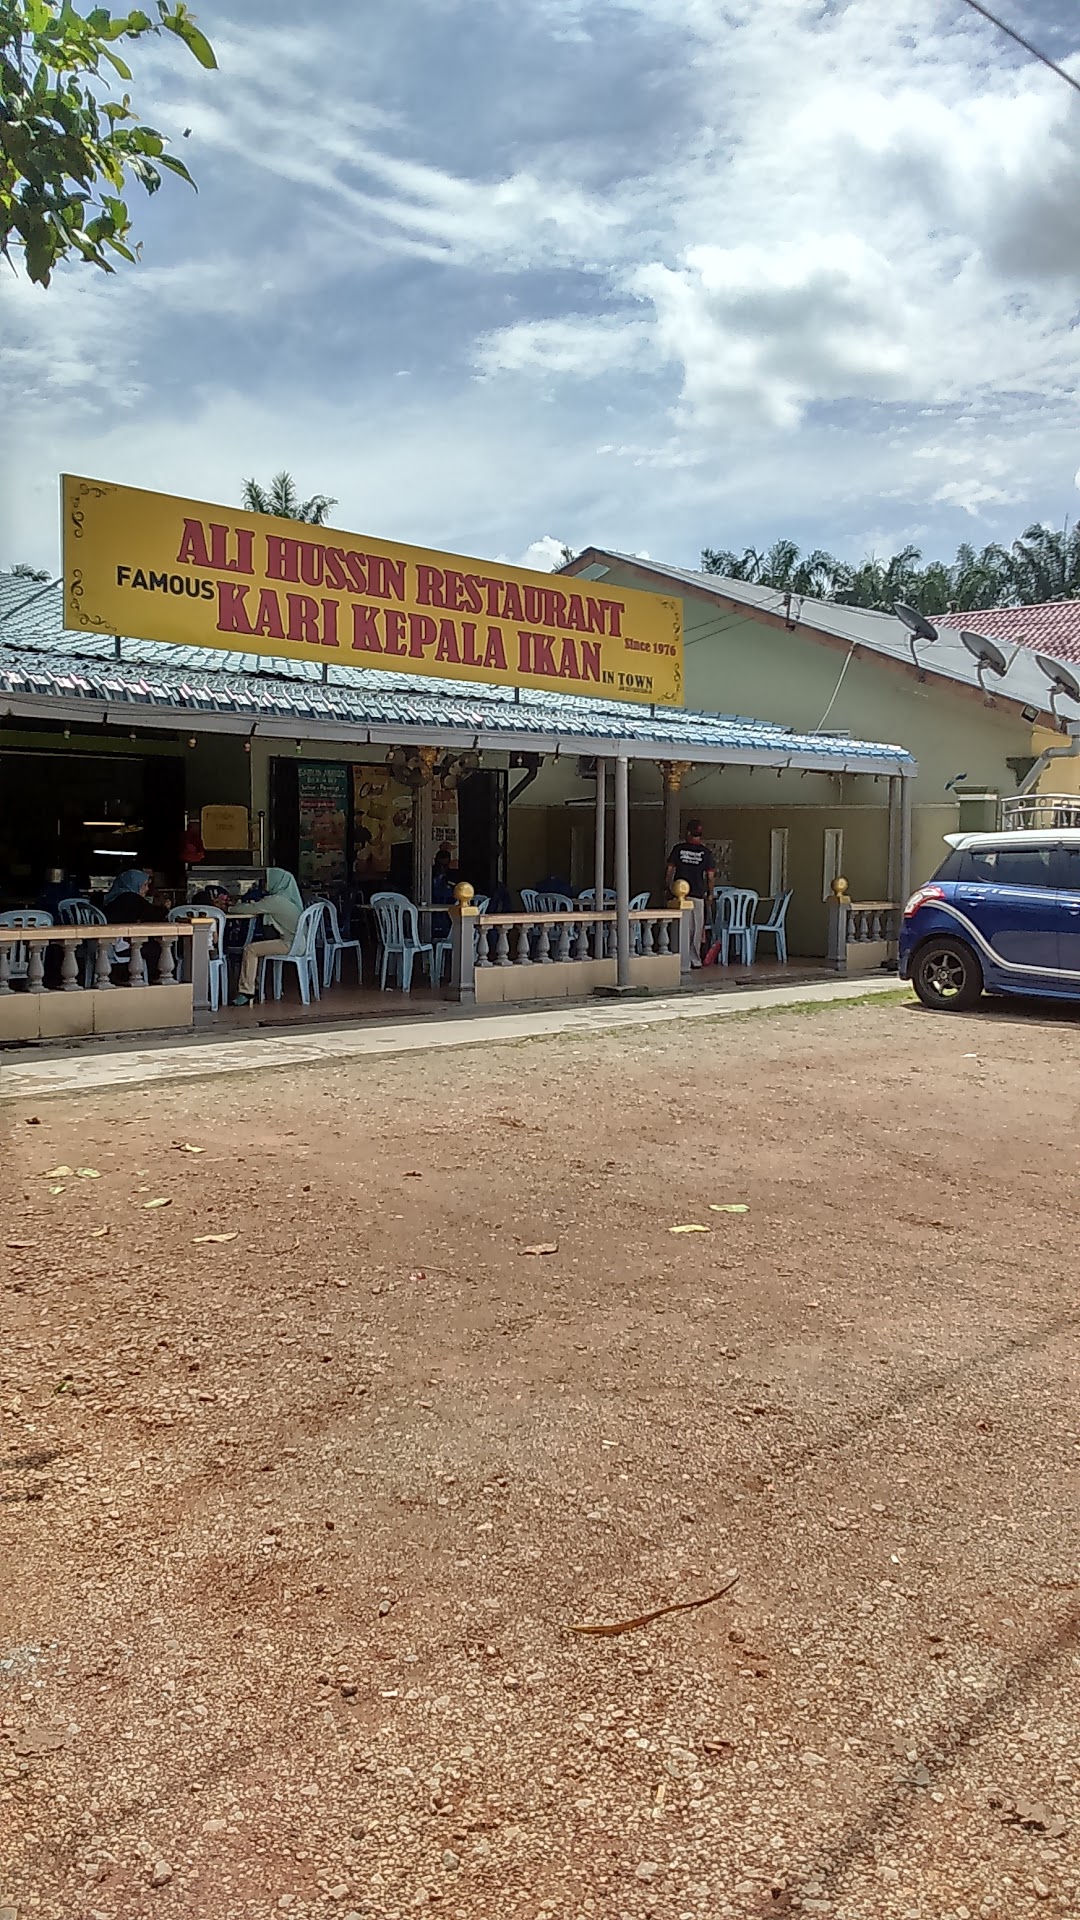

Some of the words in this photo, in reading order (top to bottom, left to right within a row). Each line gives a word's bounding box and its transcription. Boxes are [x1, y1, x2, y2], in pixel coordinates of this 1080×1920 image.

[116, 565, 215, 600] FAMOUS
[176, 517, 255, 575] ALI
[265, 534, 407, 601] HUSSIN
[415, 564, 625, 637] RESTAURANT
[216, 580, 340, 648] KARI
[351, 603, 508, 671] KEPALA
[516, 631, 602, 682] IKAN
[624, 637, 651, 652] Since
[653, 642, 677, 656] 1976
[602, 670, 615, 684] IN
[618, 672, 653, 689] TOWN
